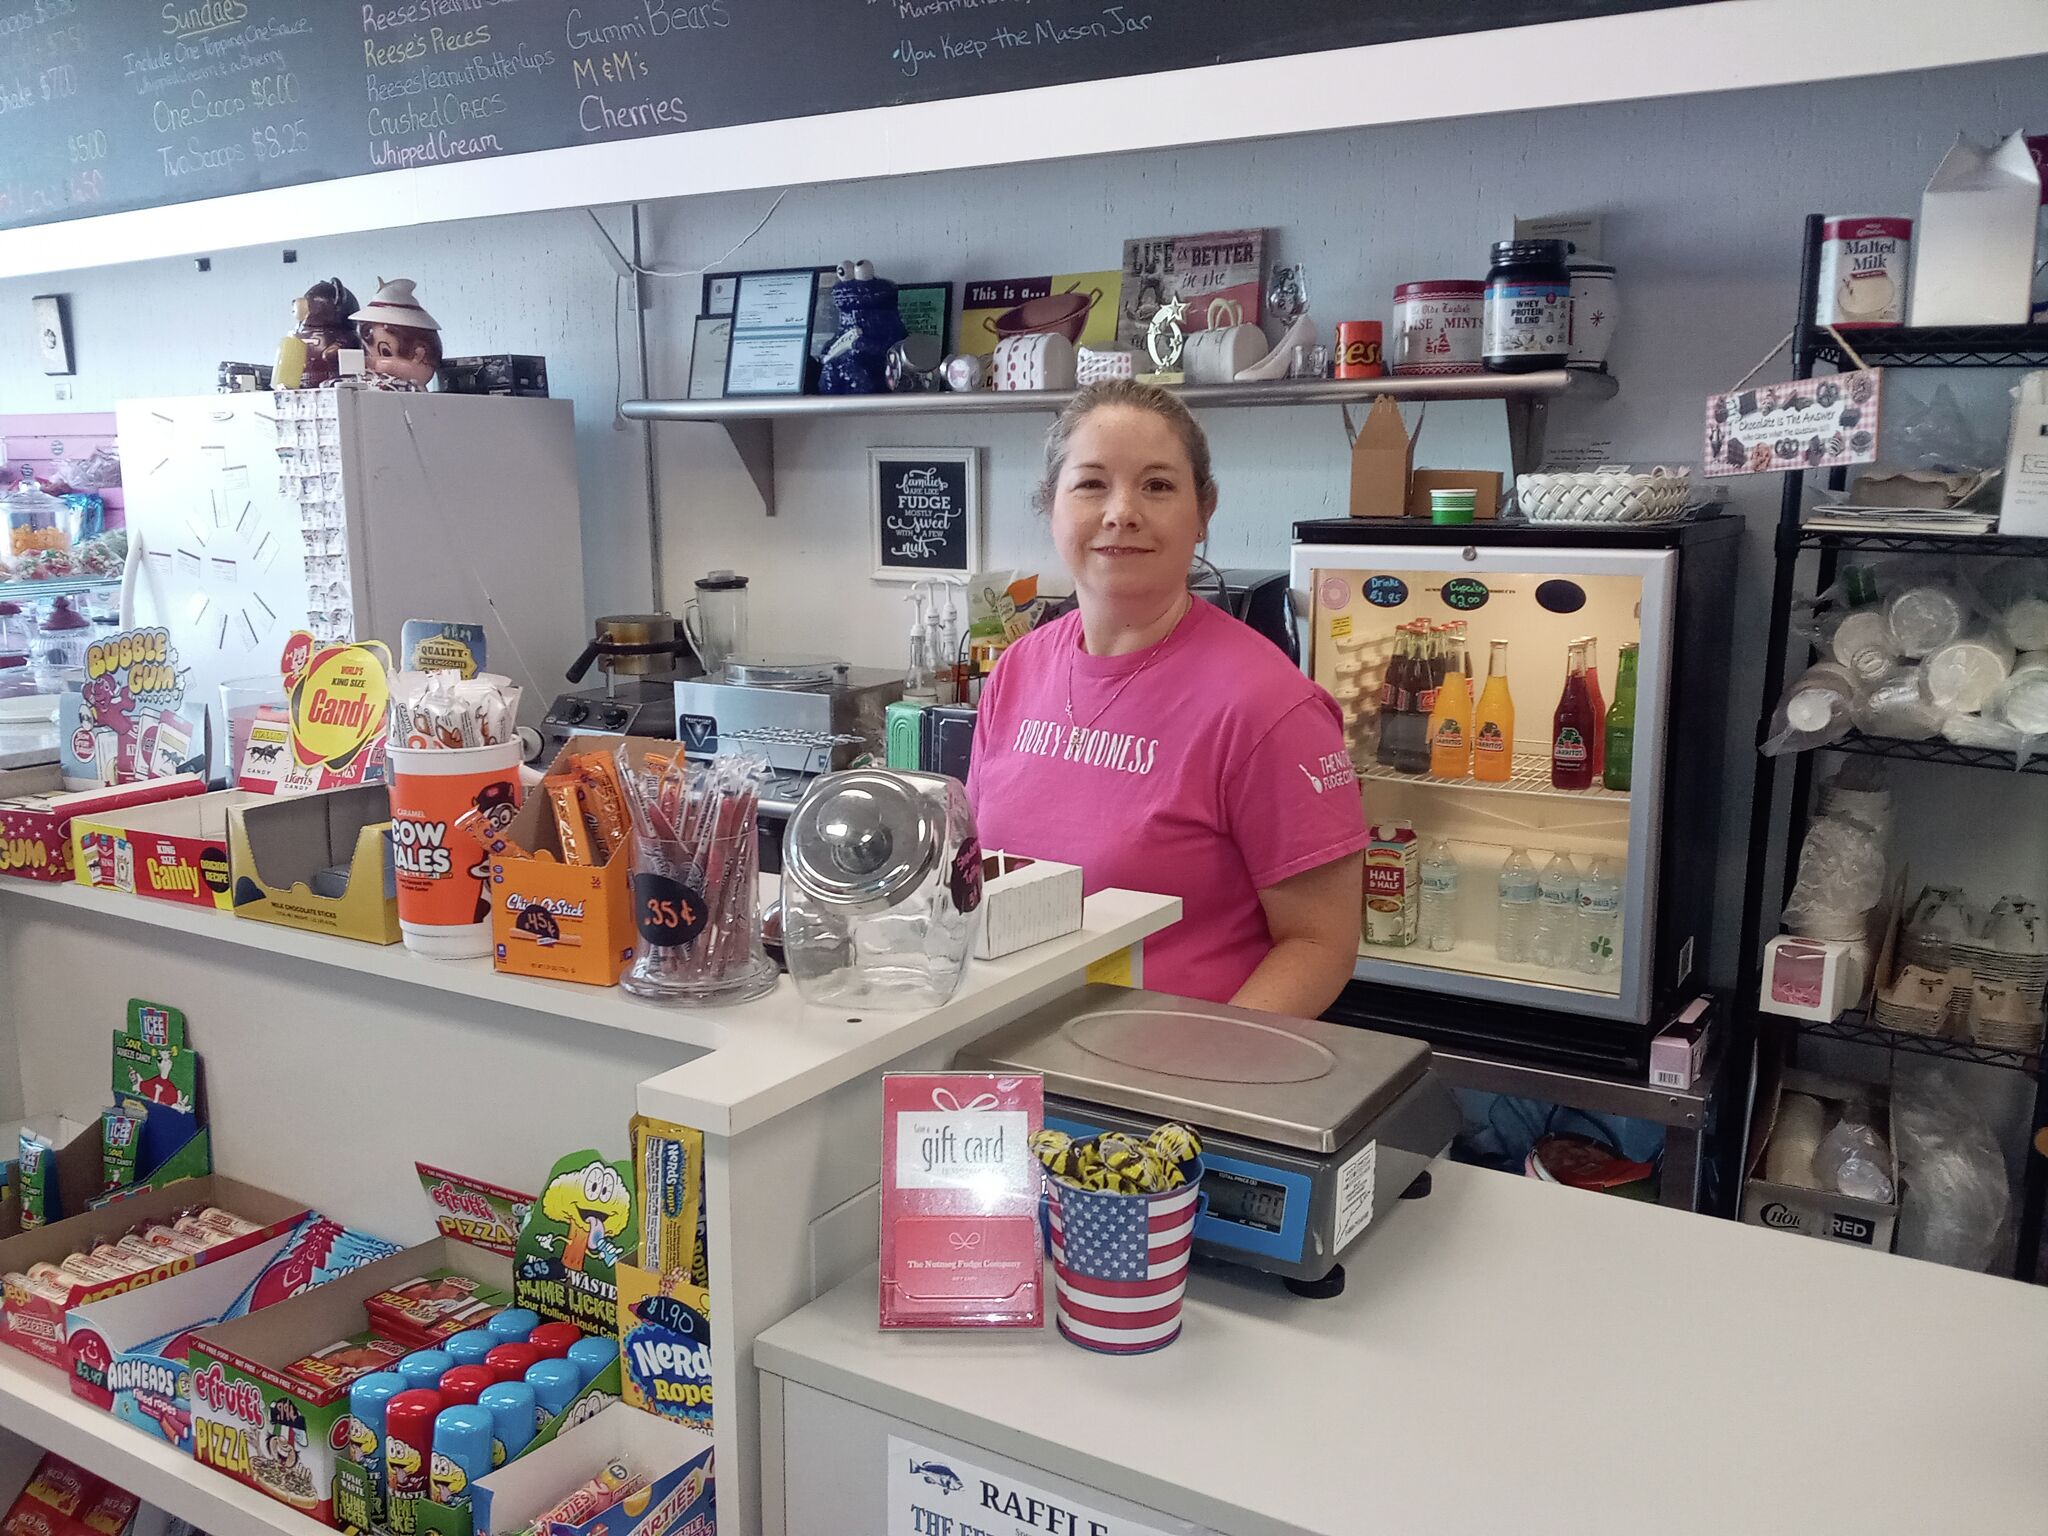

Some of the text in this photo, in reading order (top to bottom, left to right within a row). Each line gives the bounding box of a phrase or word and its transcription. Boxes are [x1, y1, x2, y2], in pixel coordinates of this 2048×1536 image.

[566, 8, 646, 50] Gummi
[900, 6, 1152, 77] You Keep the Mason Jar
[363, 25, 492, 68] Reese's Pieces
[579, 95, 688, 132] Cherries
[369, 131, 503, 168] Whipped Cream
[1191, 242, 1254, 268] BETTER
[1844, 240, 1897, 255] Malted
[1852, 254, 1888, 271] Milk
[972, 287, 998, 301] This
[1003, 285, 1015, 300] is
[1516, 301, 1540, 309] WHEY
[1511, 308, 1544, 317] PROTEIN
[1514, 316, 1541, 325] BLEND
[898, 496, 951, 509] FUDGE
[904, 509, 933, 517] MOSTLY
[88, 632, 167, 680] BUBBLE
[421, 646, 464, 658] QUALITY
[128, 664, 175, 694] GUM
[350, 679, 367, 688] SIZE
[308, 688, 377, 739] Candy
[247, 768, 272, 776] CANDY
[397, 808, 426, 818] CARAMEL
[392, 817, 446, 847] COW
[393, 842, 451, 873] TALES
[147, 857, 200, 898] Candy
[1369, 869, 1400, 881] HALF
[1369, 880, 1400, 889] & HALF
[922, 1125, 1004, 1172] gift card
[439, 1215, 513, 1246] PIZZA
[907, 1260, 1022, 1270] The Nutmeg Fudge Company
[571, 1270, 618, 1300] WASTE
[374, 1291, 418, 1311] PIZZA
[517, 1295, 598, 1334] Sour Rolling Liquid
[568, 1287, 616, 1325] LICKE
[647, 1297, 694, 1334] $1.90
[107, 1359, 175, 1397] AIRHEADS
[295, 1358, 341, 1377] PIZZA
[195, 1416, 251, 1476] PIZZA
